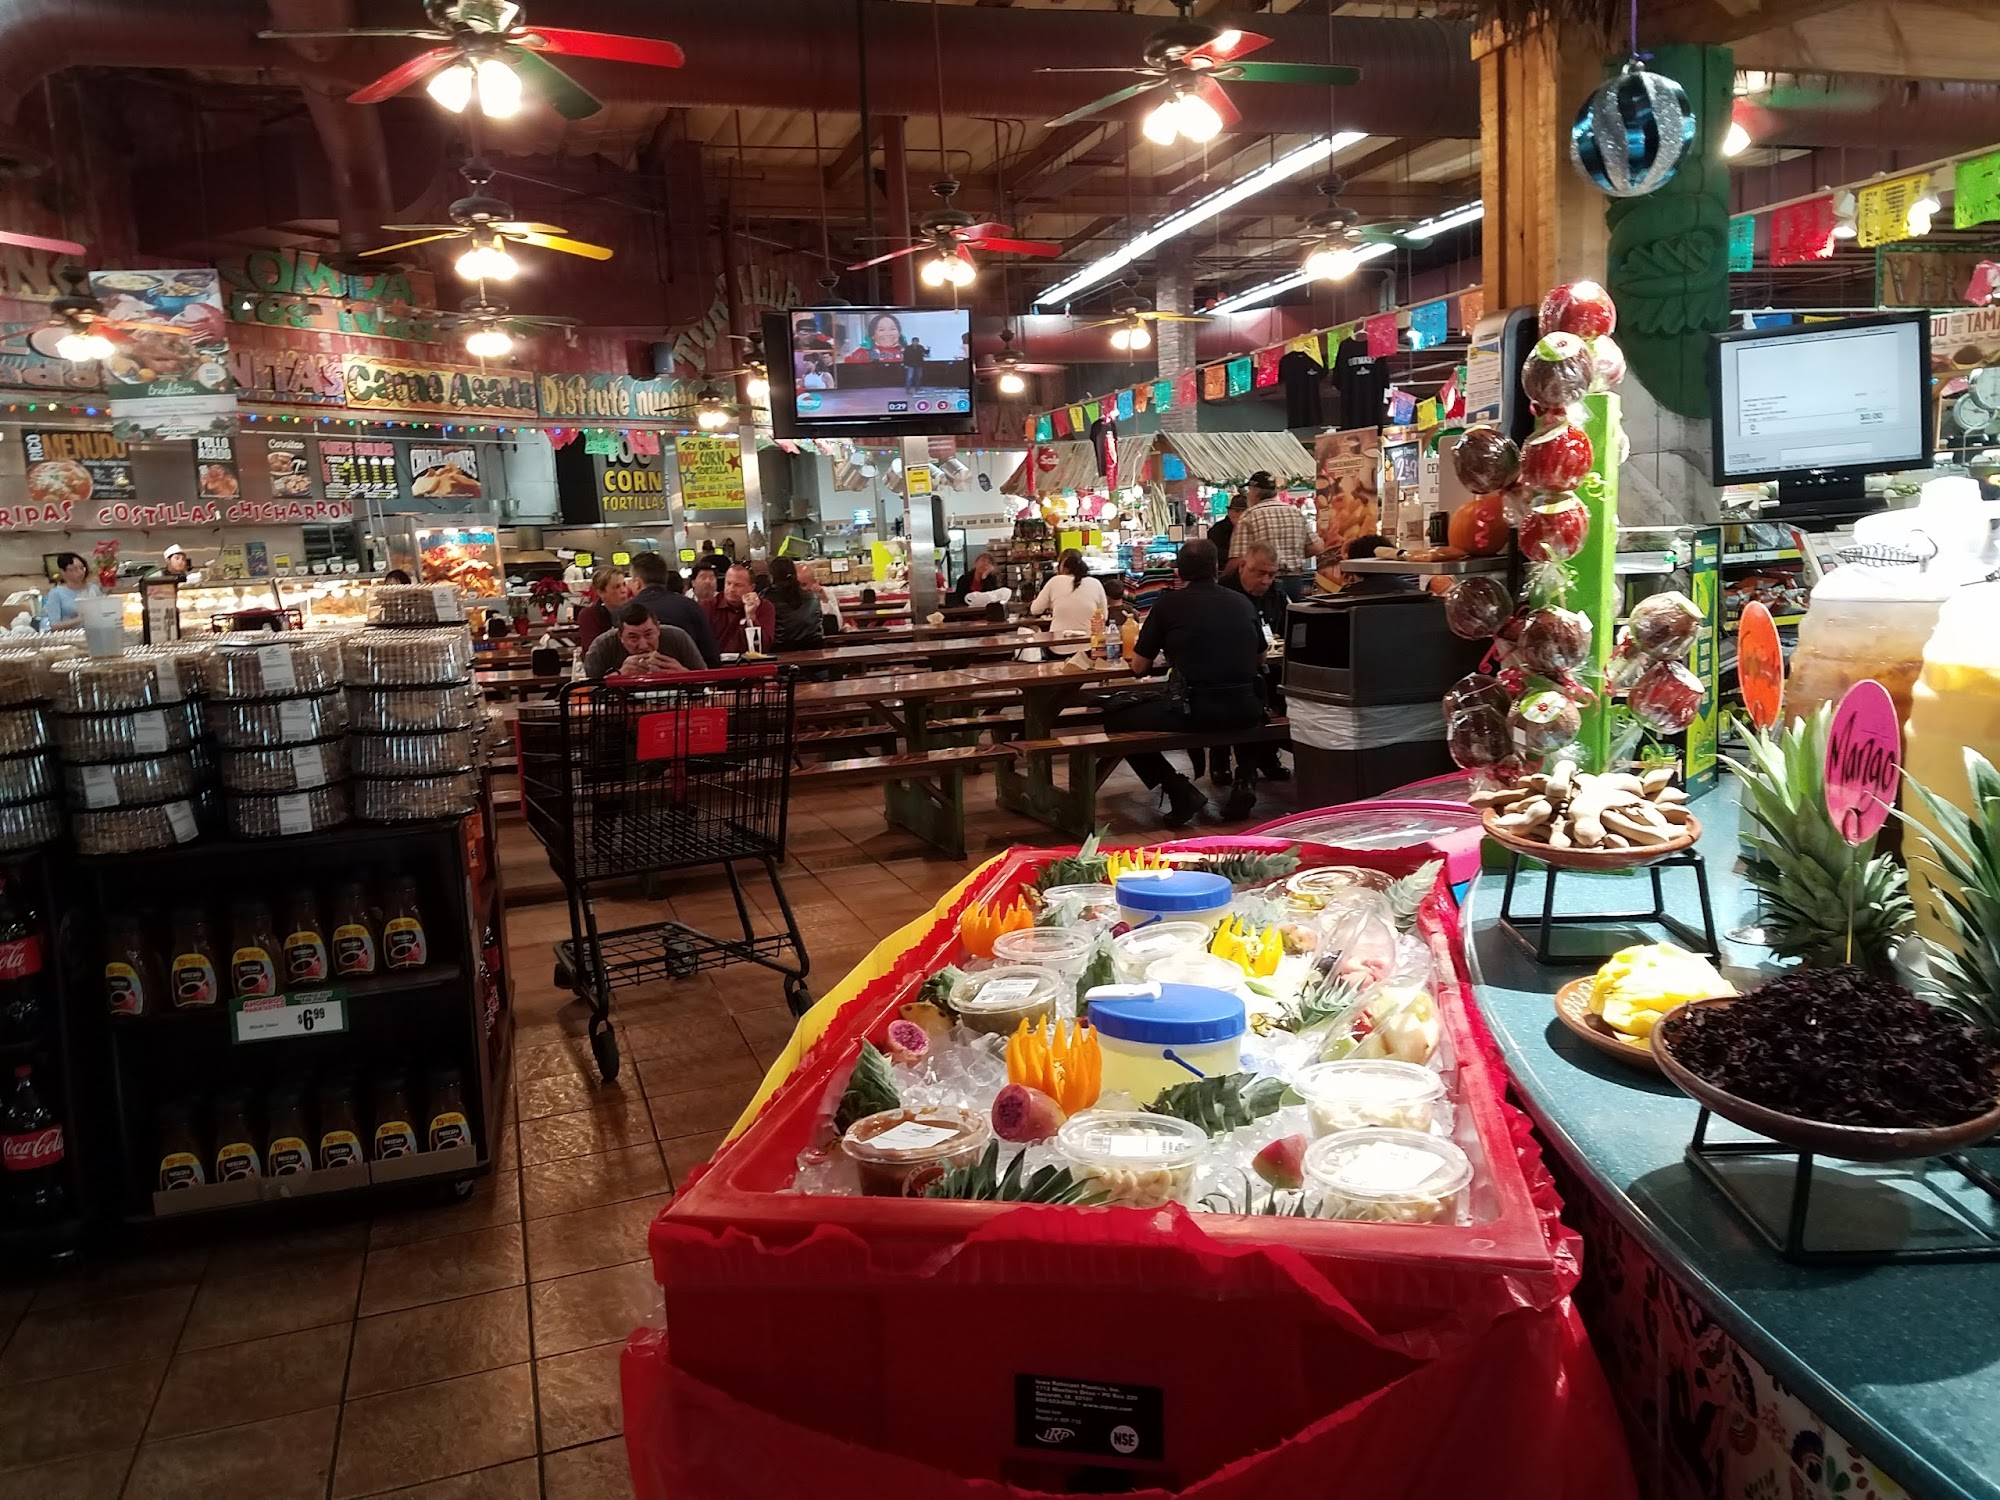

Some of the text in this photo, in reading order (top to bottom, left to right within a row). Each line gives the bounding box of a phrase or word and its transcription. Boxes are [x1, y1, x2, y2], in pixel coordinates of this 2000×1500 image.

[542, 374, 630, 416] Disfrute
[41, 432, 129, 460] MENUDO
[698, 440, 713, 450] ONE
[699, 451, 725, 466] CORN
[603, 469, 663, 494] CORN
[97, 501, 218, 526] COSTILLAS
[226, 499, 353, 523] CHICHARRON
[602, 496, 667, 512] TORTILLAS
[1829, 711, 1896, 812] Mango
[4, 1129, 64, 1159] Coca-Cola
